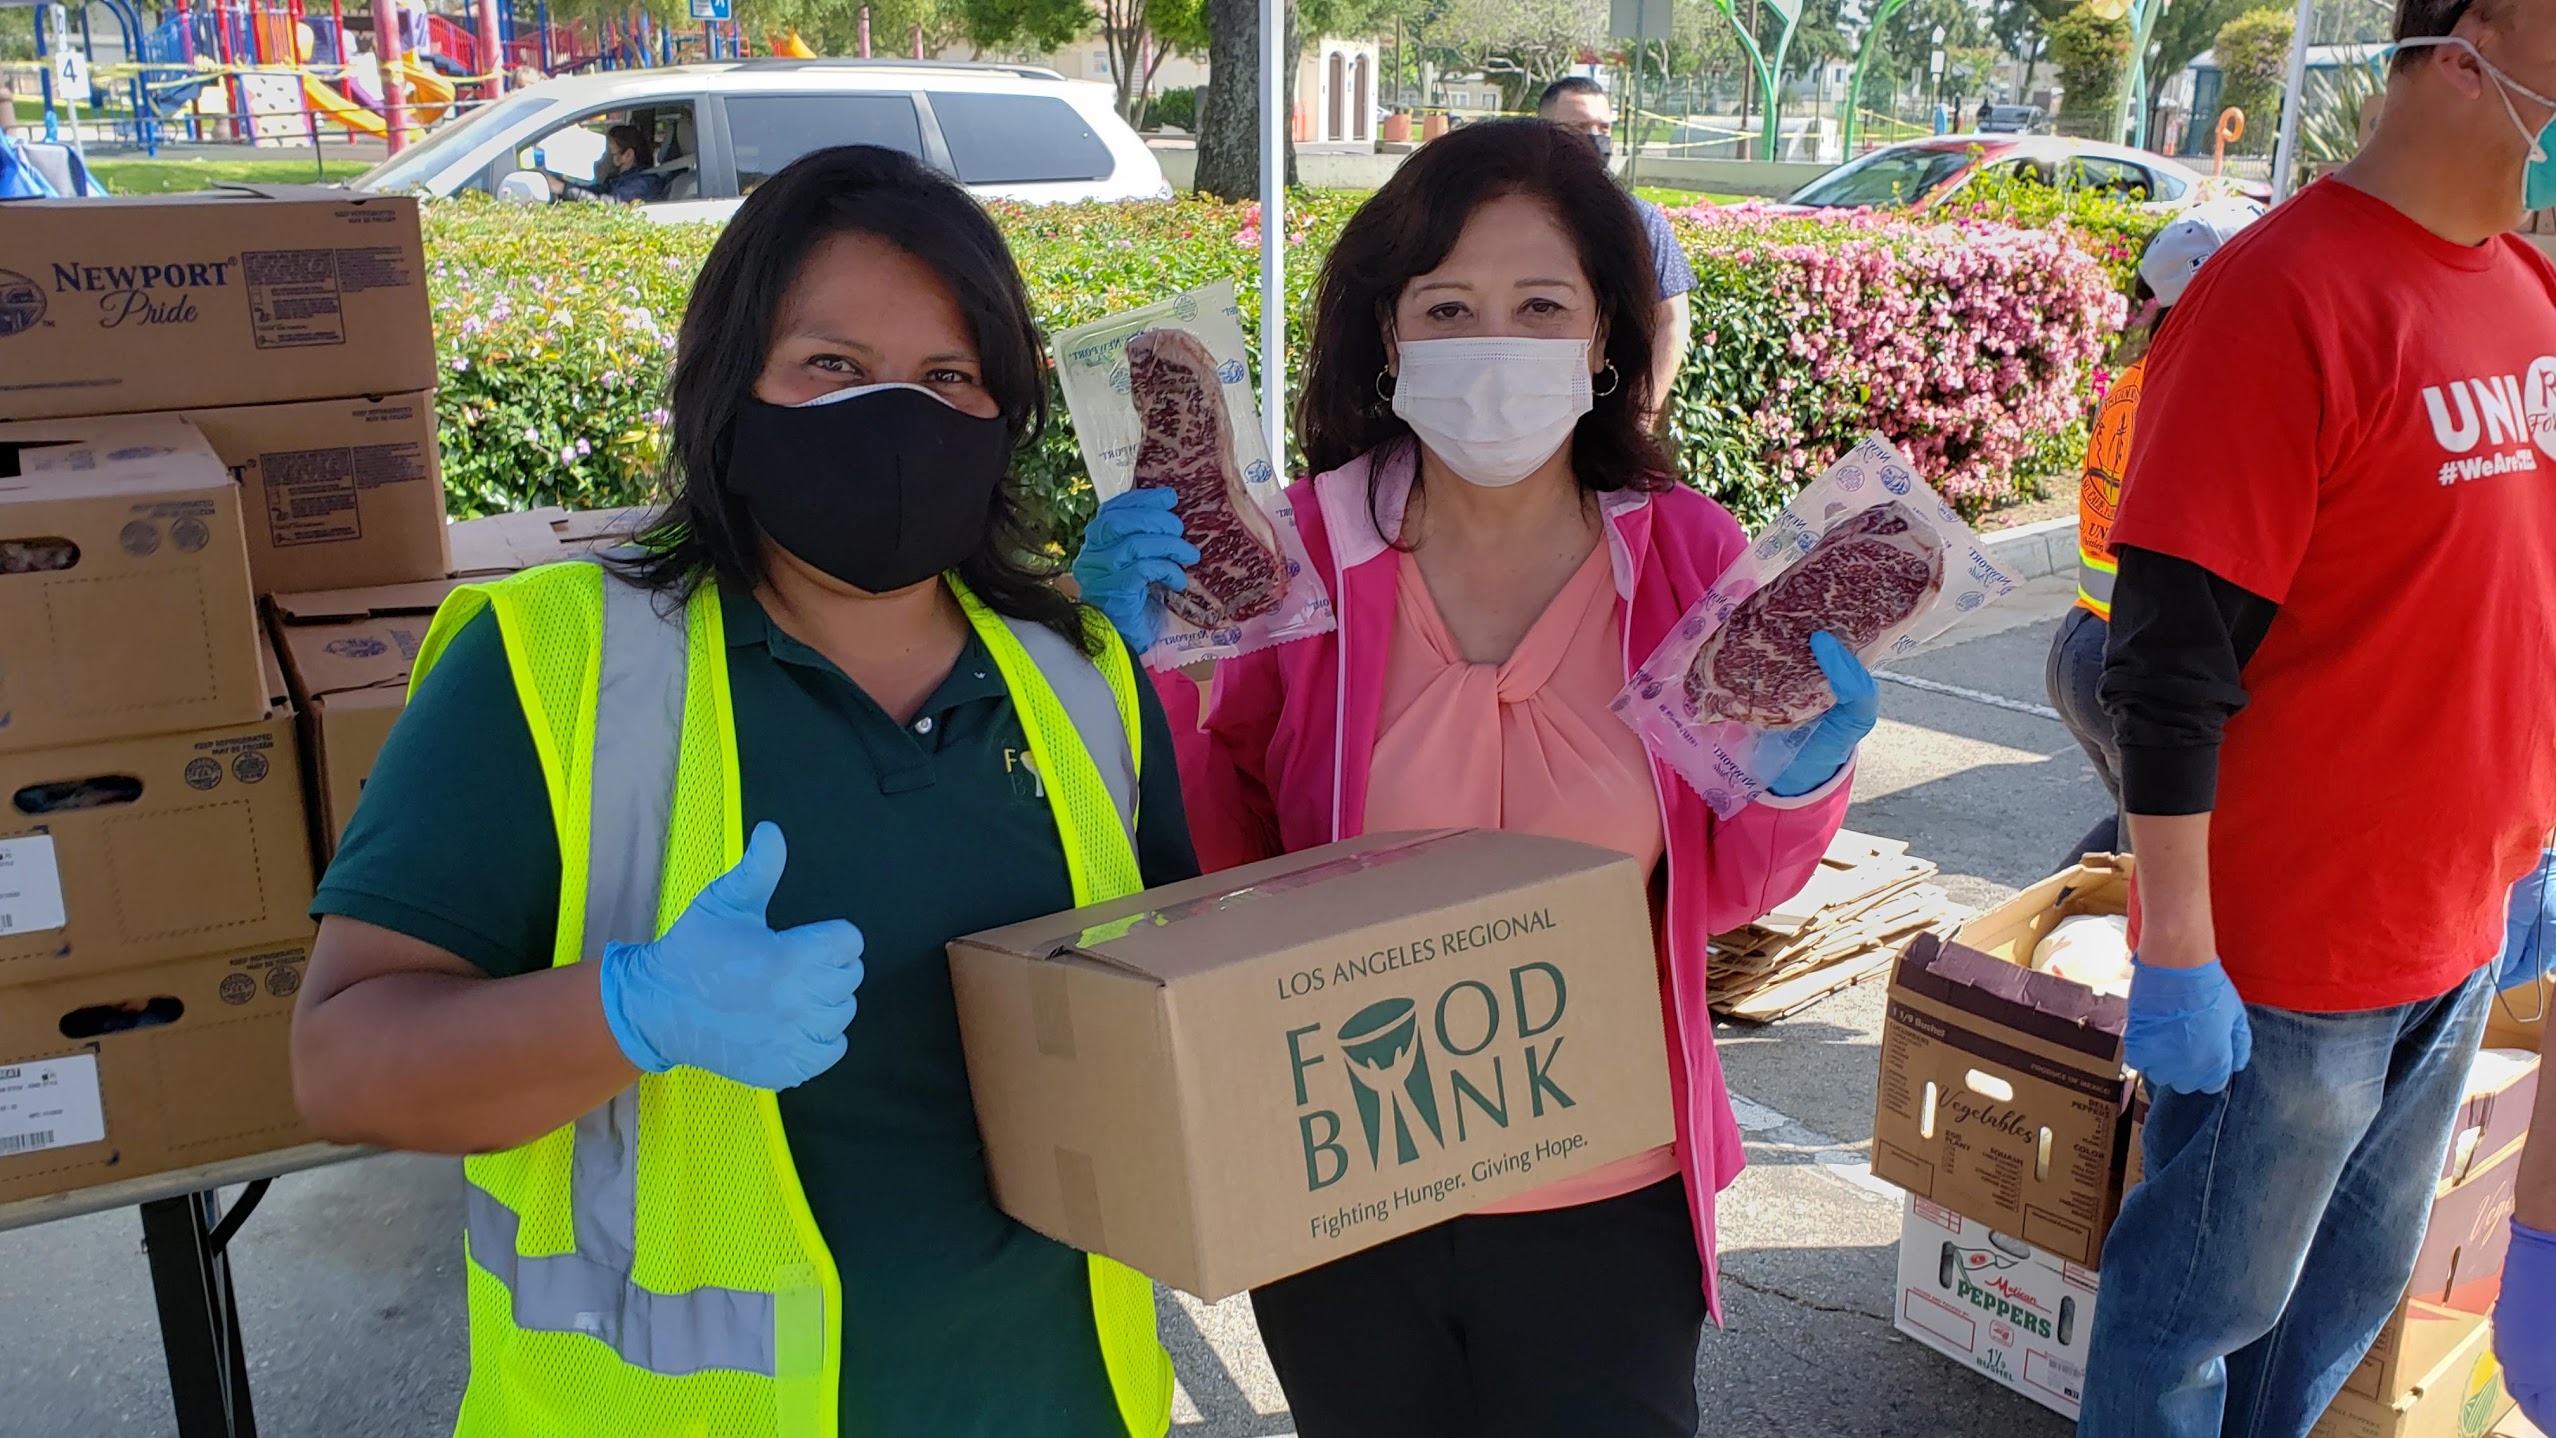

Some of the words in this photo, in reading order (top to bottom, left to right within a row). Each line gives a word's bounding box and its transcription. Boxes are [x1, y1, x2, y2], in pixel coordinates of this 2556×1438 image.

[63, 58, 78, 83] 4
[99, 289, 199, 329] Pride
[1277, 967, 1326, 1000] LOS
[1332, 938, 1436, 986] ANGELES
[1441, 908, 1557, 957] REGIONAL
[1914, 1017, 1946, 1038] Bushel
[1938, 1087, 2035, 1144] Vegetables
[1310, 1198, 1389, 1240] Fighting
[1393, 1172, 1466, 1211] Hunger.
[1471, 1149, 1532, 1182] Giving
[1535, 1132, 1589, 1164] Hope.
[2470, 1180, 2514, 1250] Vege
[1957, 1278, 2052, 1339] PEPPERS
[1976, 1356, 2015, 1383] BUSHEL
